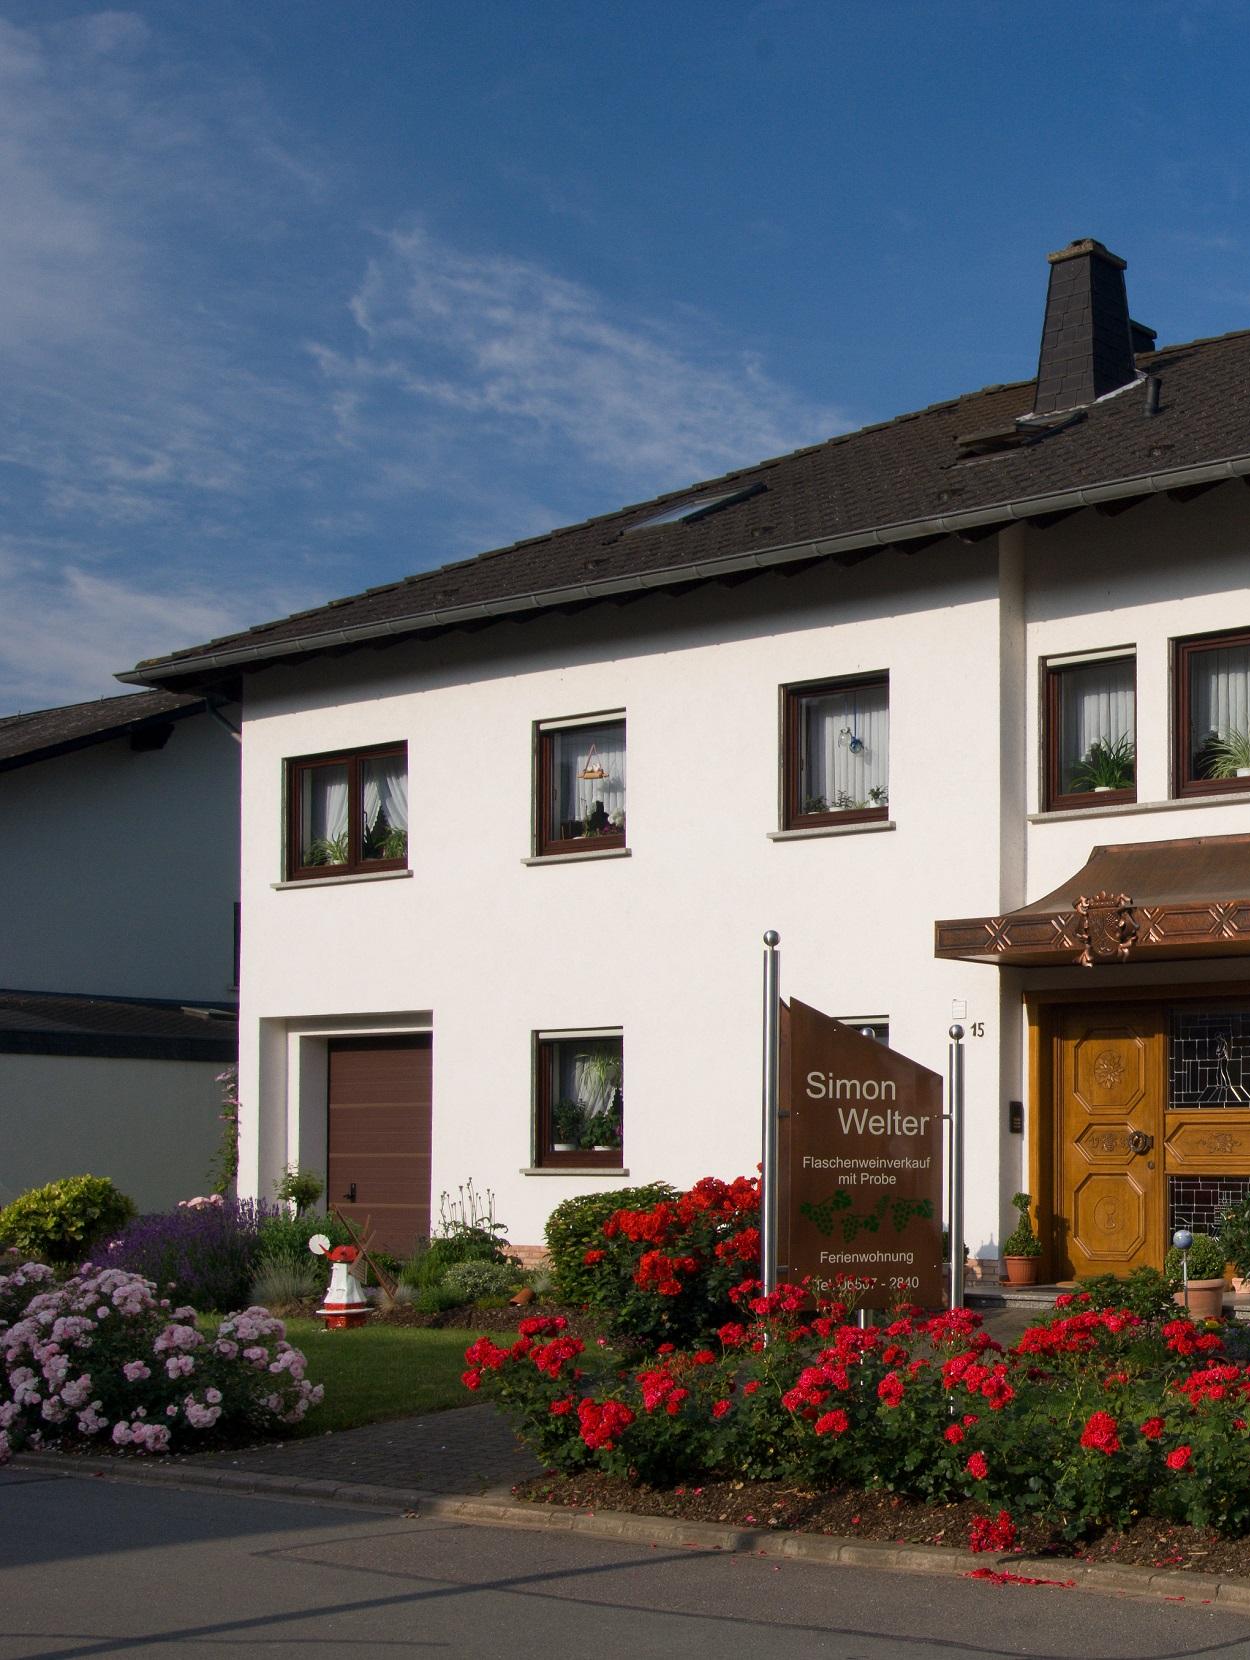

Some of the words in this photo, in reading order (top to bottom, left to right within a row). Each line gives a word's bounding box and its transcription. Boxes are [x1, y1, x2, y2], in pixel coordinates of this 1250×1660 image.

[970, 1022, 985, 1038] 15
[805, 1071, 897, 1101] Simon
[838, 1107, 930, 1136] Welter
[802, 1156, 932, 1169] Flaschenweinverkauf
[838, 1173, 857, 1185] mit
[860, 1172, 897, 1185] Probe
[820, 1251, 914, 1265] Ferienwohnung
[890, 1276, 919, 1290] 2840
